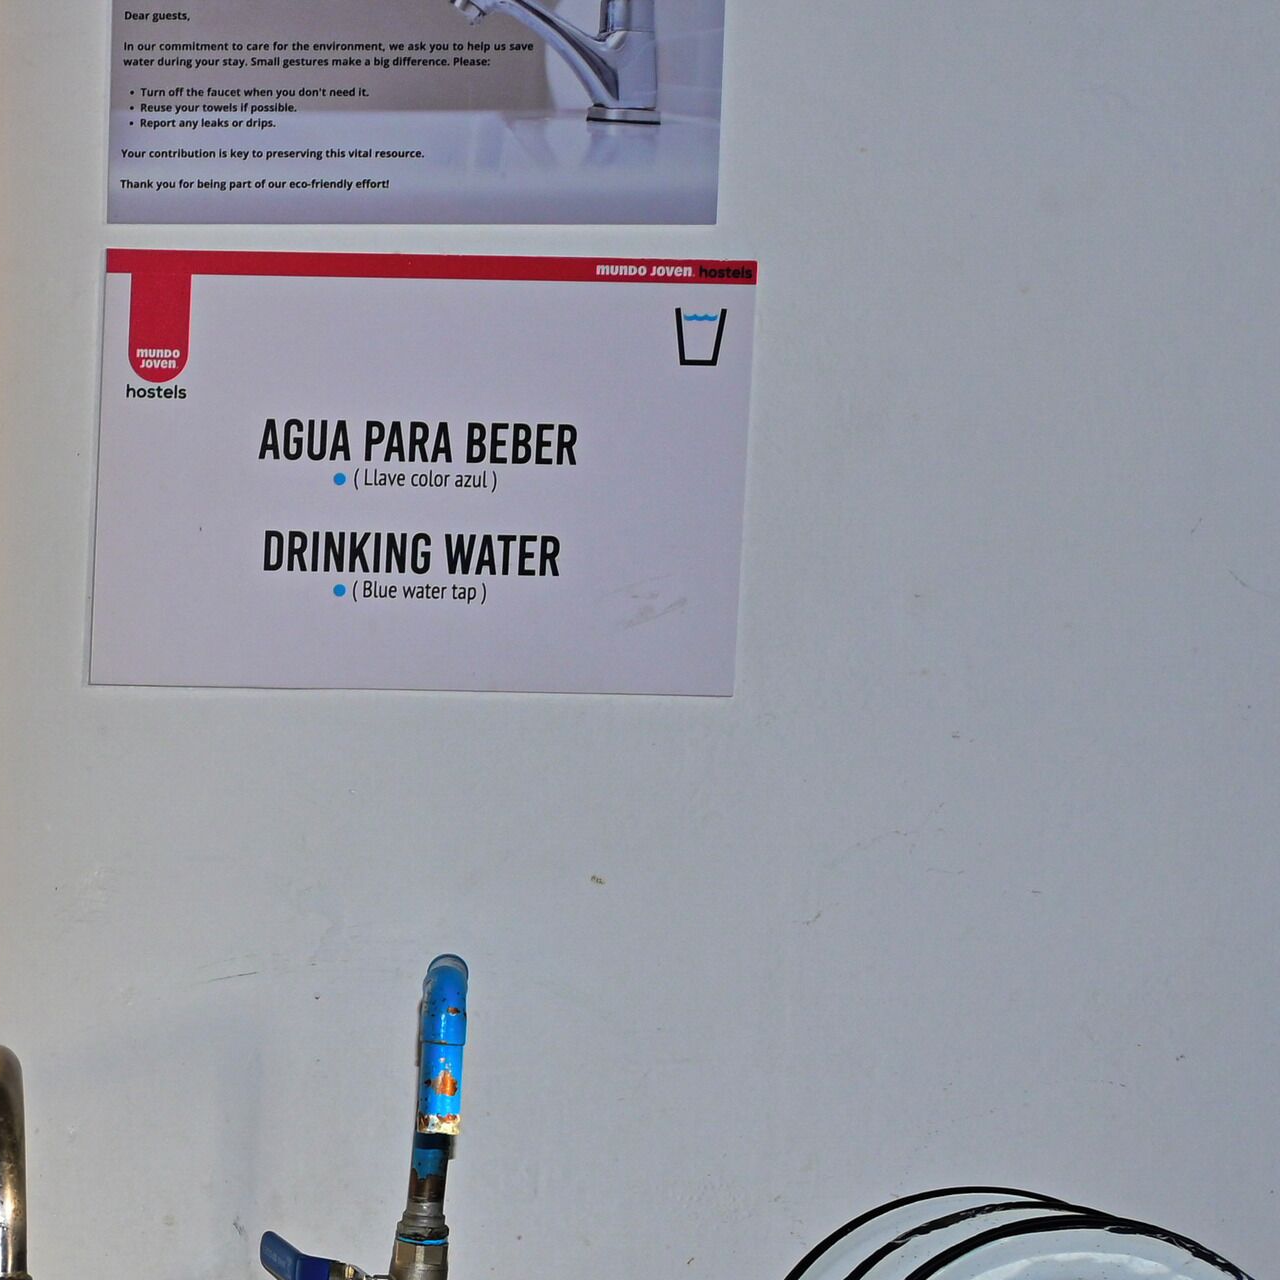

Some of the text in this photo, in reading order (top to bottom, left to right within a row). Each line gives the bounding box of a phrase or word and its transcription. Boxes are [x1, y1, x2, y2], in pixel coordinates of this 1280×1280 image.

[124, 11, 190, 22] Dear guests,
[123, 41, 134, 51] In
[137, 43, 156, 51] our
[159, 41, 228, 51] commitment
[231, 42, 243, 51] to
[246, 43, 269, 51] care
[272, 40, 288, 51] for
[291, 41, 309, 51] the
[312, 40, 385, 52] environment,
[407, 41, 426, 51] ask
[429, 43, 448, 53] you
[452, 42, 463, 51] to
[467, 41, 490, 53] help
[493, 43, 506, 51] us
[509, 43, 533, 51] save
[140, 87, 369, 99] Turn off the faucet when you don't need it.
[140, 102, 296, 115] Reuse your towels if possible.
[140, 118, 176, 130] Report
[178, 120, 198, 130] any
[201, 118, 229, 127] leaks
[245, 117, 275, 130] drips.
[120, 148, 424, 160] Your contribution is key to preserving this vital resource.
[698, 266, 752, 279] hostels
[126, 383, 187, 399] hostels
[258, 417, 577, 465] AGUA PARA BEBER
[364, 468, 488, 488] Llave color azul
[263, 530, 560, 576] DRINKING WATER
[362, 579, 476, 605] Blue water tap
